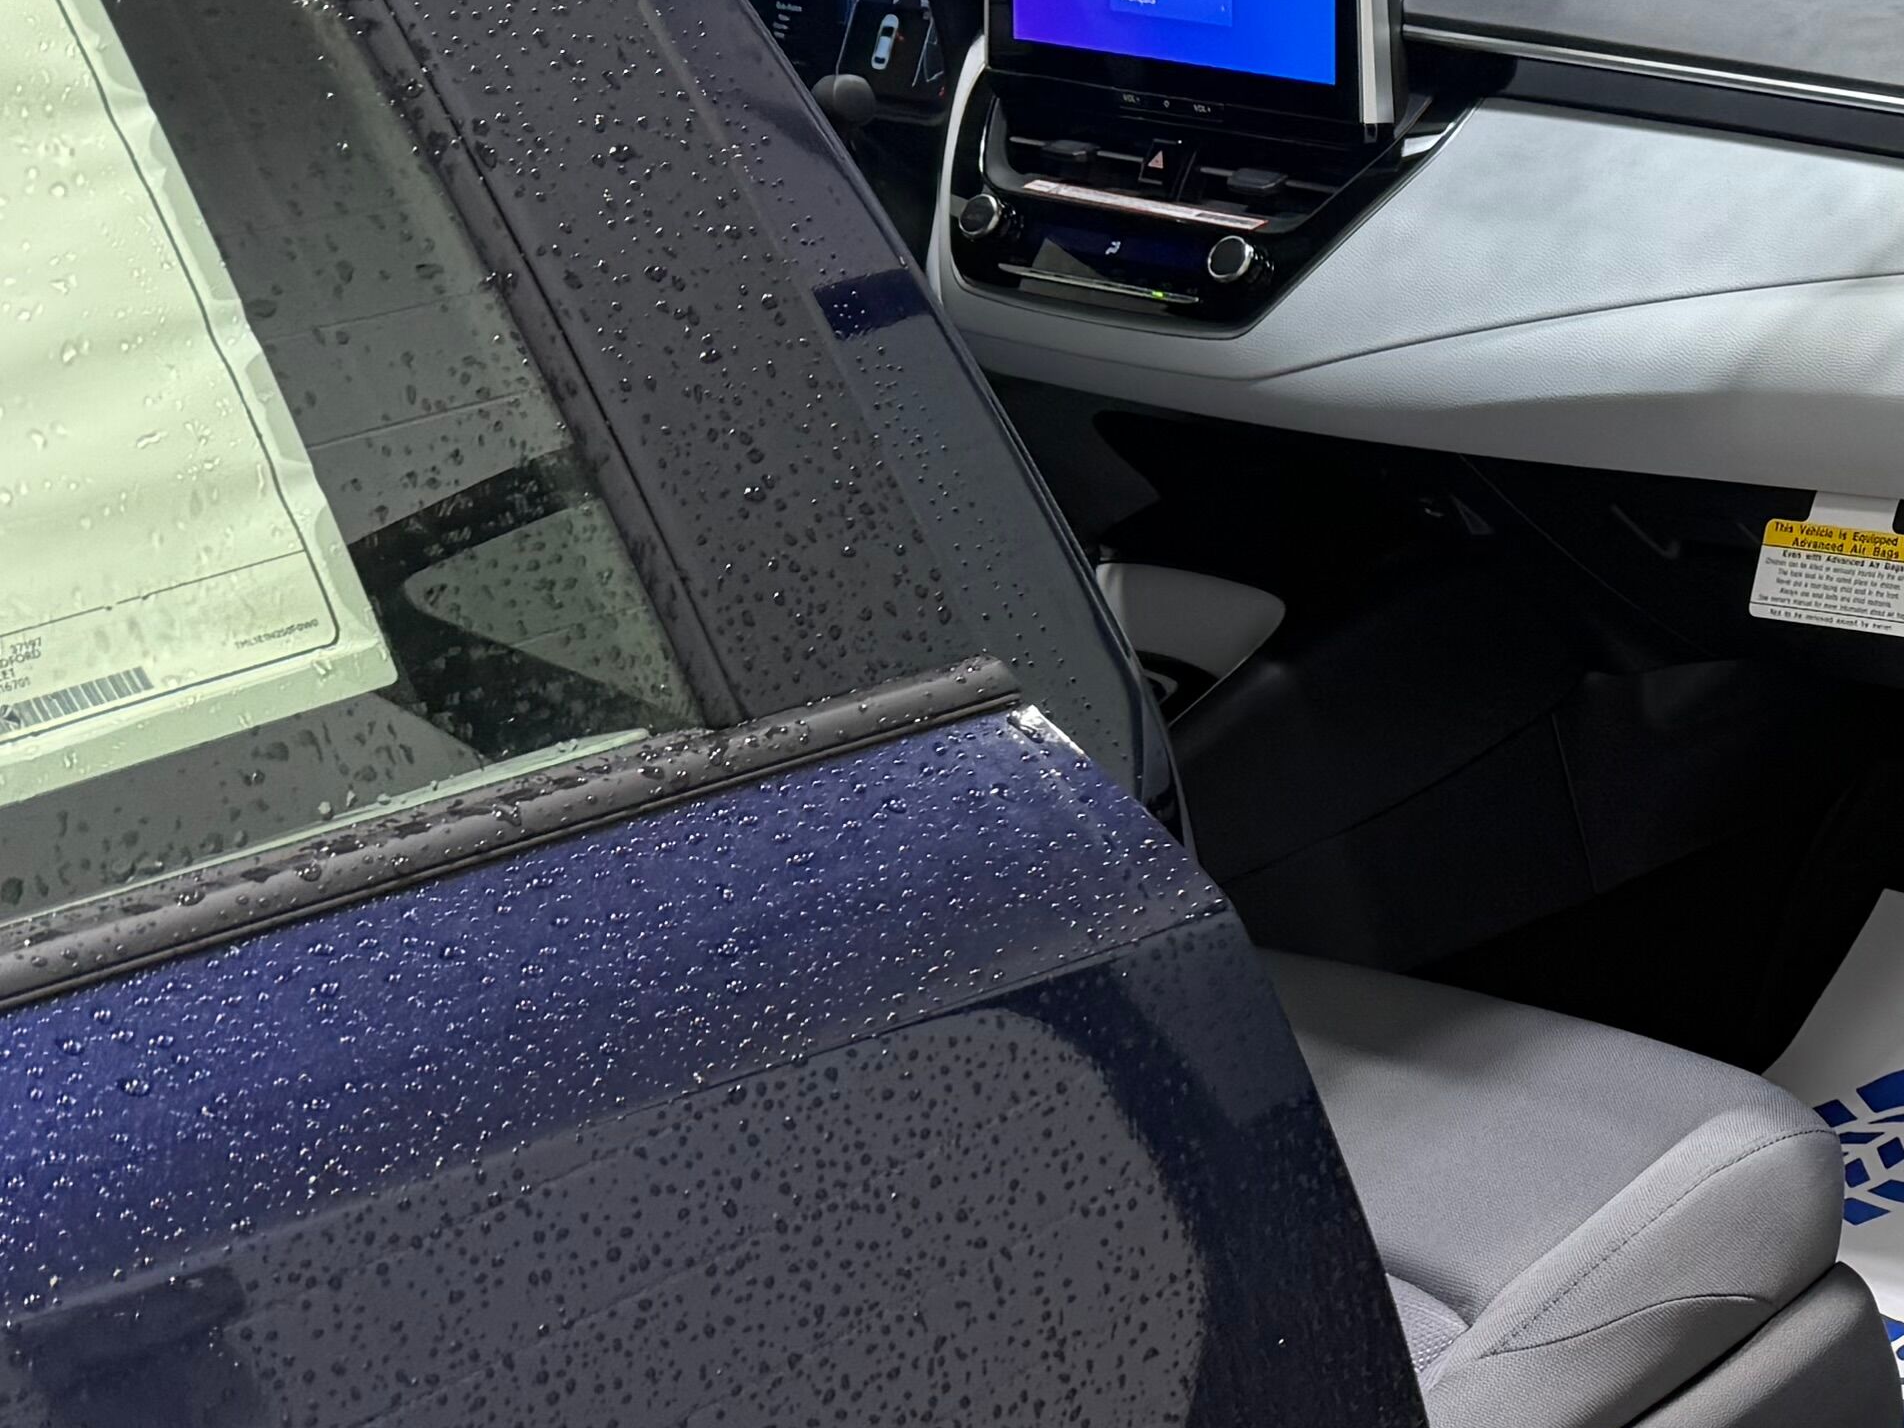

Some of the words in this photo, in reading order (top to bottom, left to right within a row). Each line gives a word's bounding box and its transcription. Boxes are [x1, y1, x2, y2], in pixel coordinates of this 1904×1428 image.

[1775, 521, 1794, 533] This
[1800, 524, 1833, 538] Vehicle
[1853, 531, 1899, 547] Equipped
[1792, 537, 1844, 552] Advanced
[1850, 544, 1866, 555] Air
[1873, 547, 1899, 560] Bags
